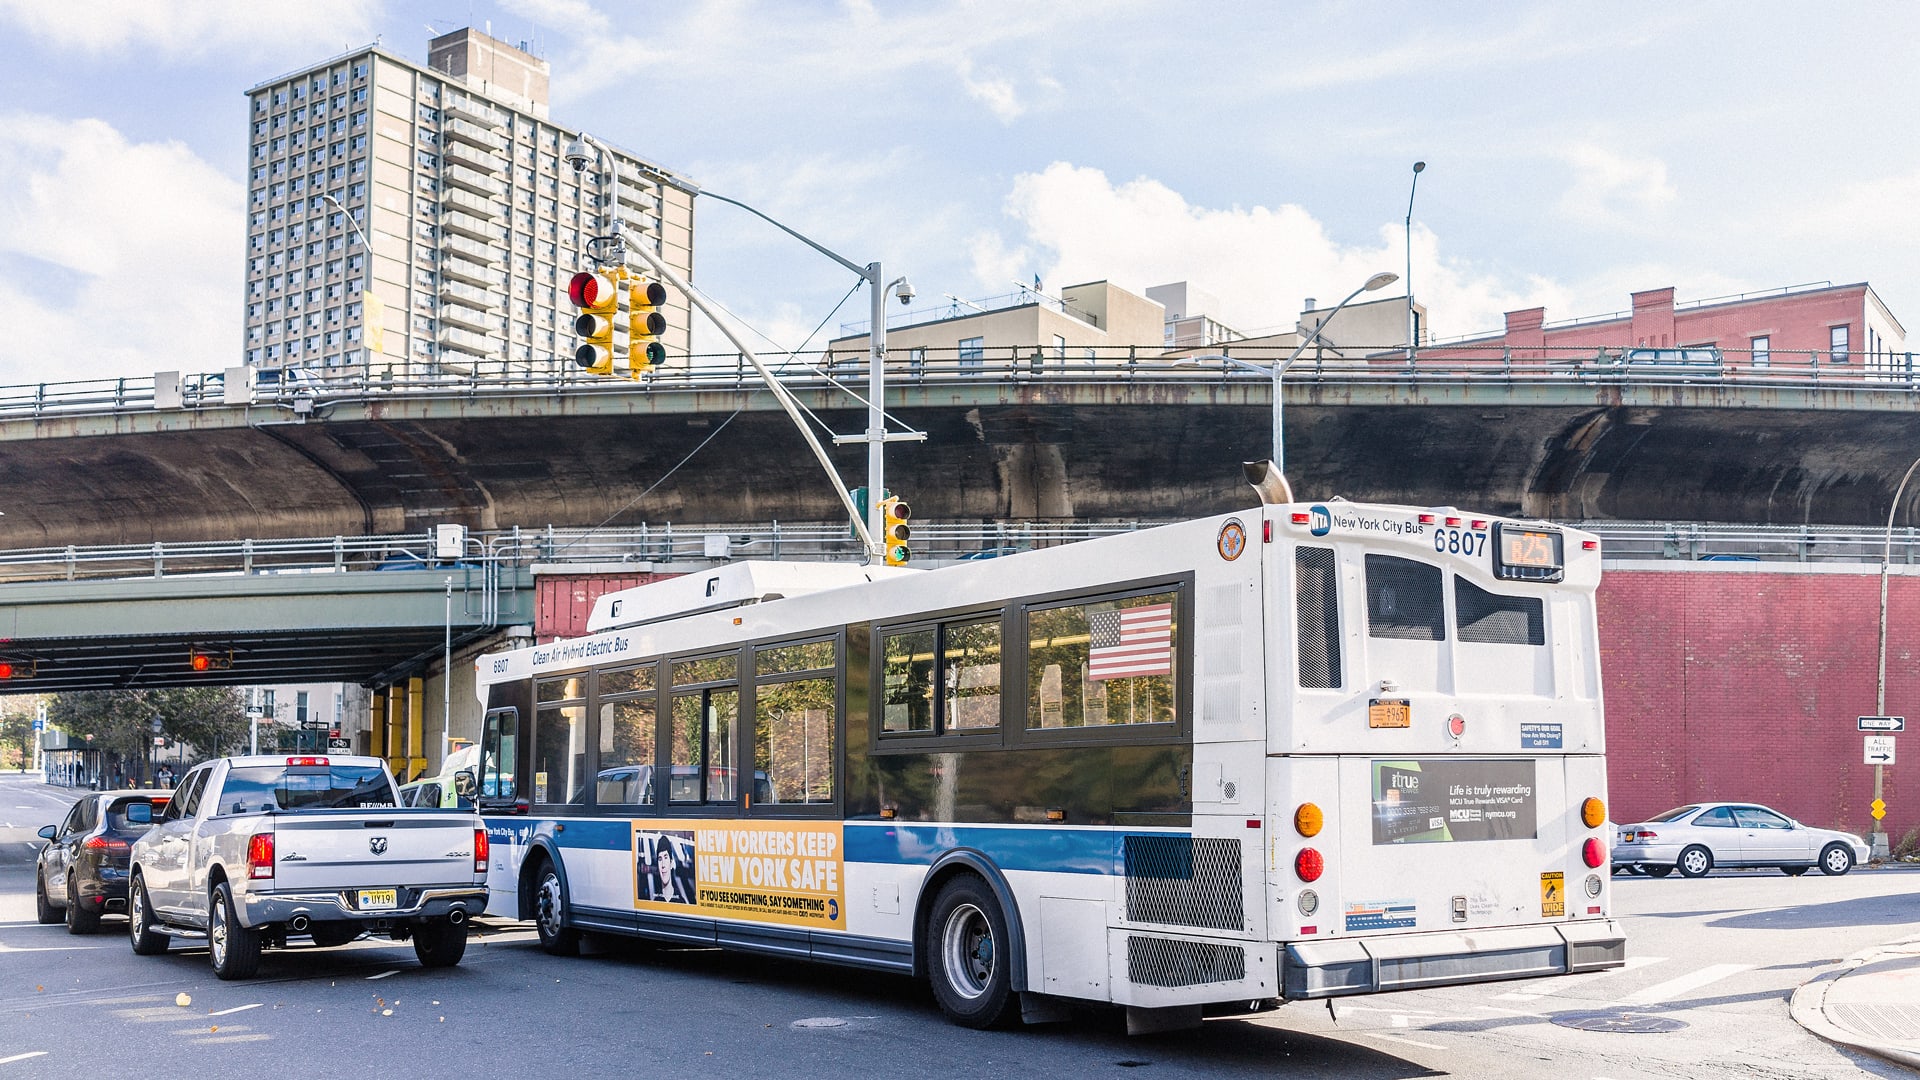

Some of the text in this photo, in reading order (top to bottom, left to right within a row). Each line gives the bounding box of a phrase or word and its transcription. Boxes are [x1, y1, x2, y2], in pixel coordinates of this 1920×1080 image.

[1309, 511, 1329, 530] MTA
[1333, 515, 1424, 534] New York City Bus
[1434, 528, 1487, 558] 6807
[1511, 532, 1549, 566] B25
[532, 636, 629, 666] Clean Air Hybrid Electric Bus
[493, 658, 509, 674] 6807
[1449, 783, 1531, 797] Life is truly rewarding
[1475, 797, 1496, 805] Rewards
[1511, 796, 1523, 804] Card
[1449, 809, 1470, 819] MCU
[1485, 810, 1516, 820] nymcu.org
[698, 829, 836, 858] NEW YORKERS KEEP
[699, 854, 838, 892] NEW YORK SAFE
[699, 889, 706, 901] IF
[706, 890, 718, 902] YOU
[718, 891, 730, 903] SEE
[730, 892, 769, 908] SOMETHING,
[769, 896, 783, 908] SAY
[783, 897, 825, 912] SOMETHING
[1542, 903, 1564, 913] WIDE
